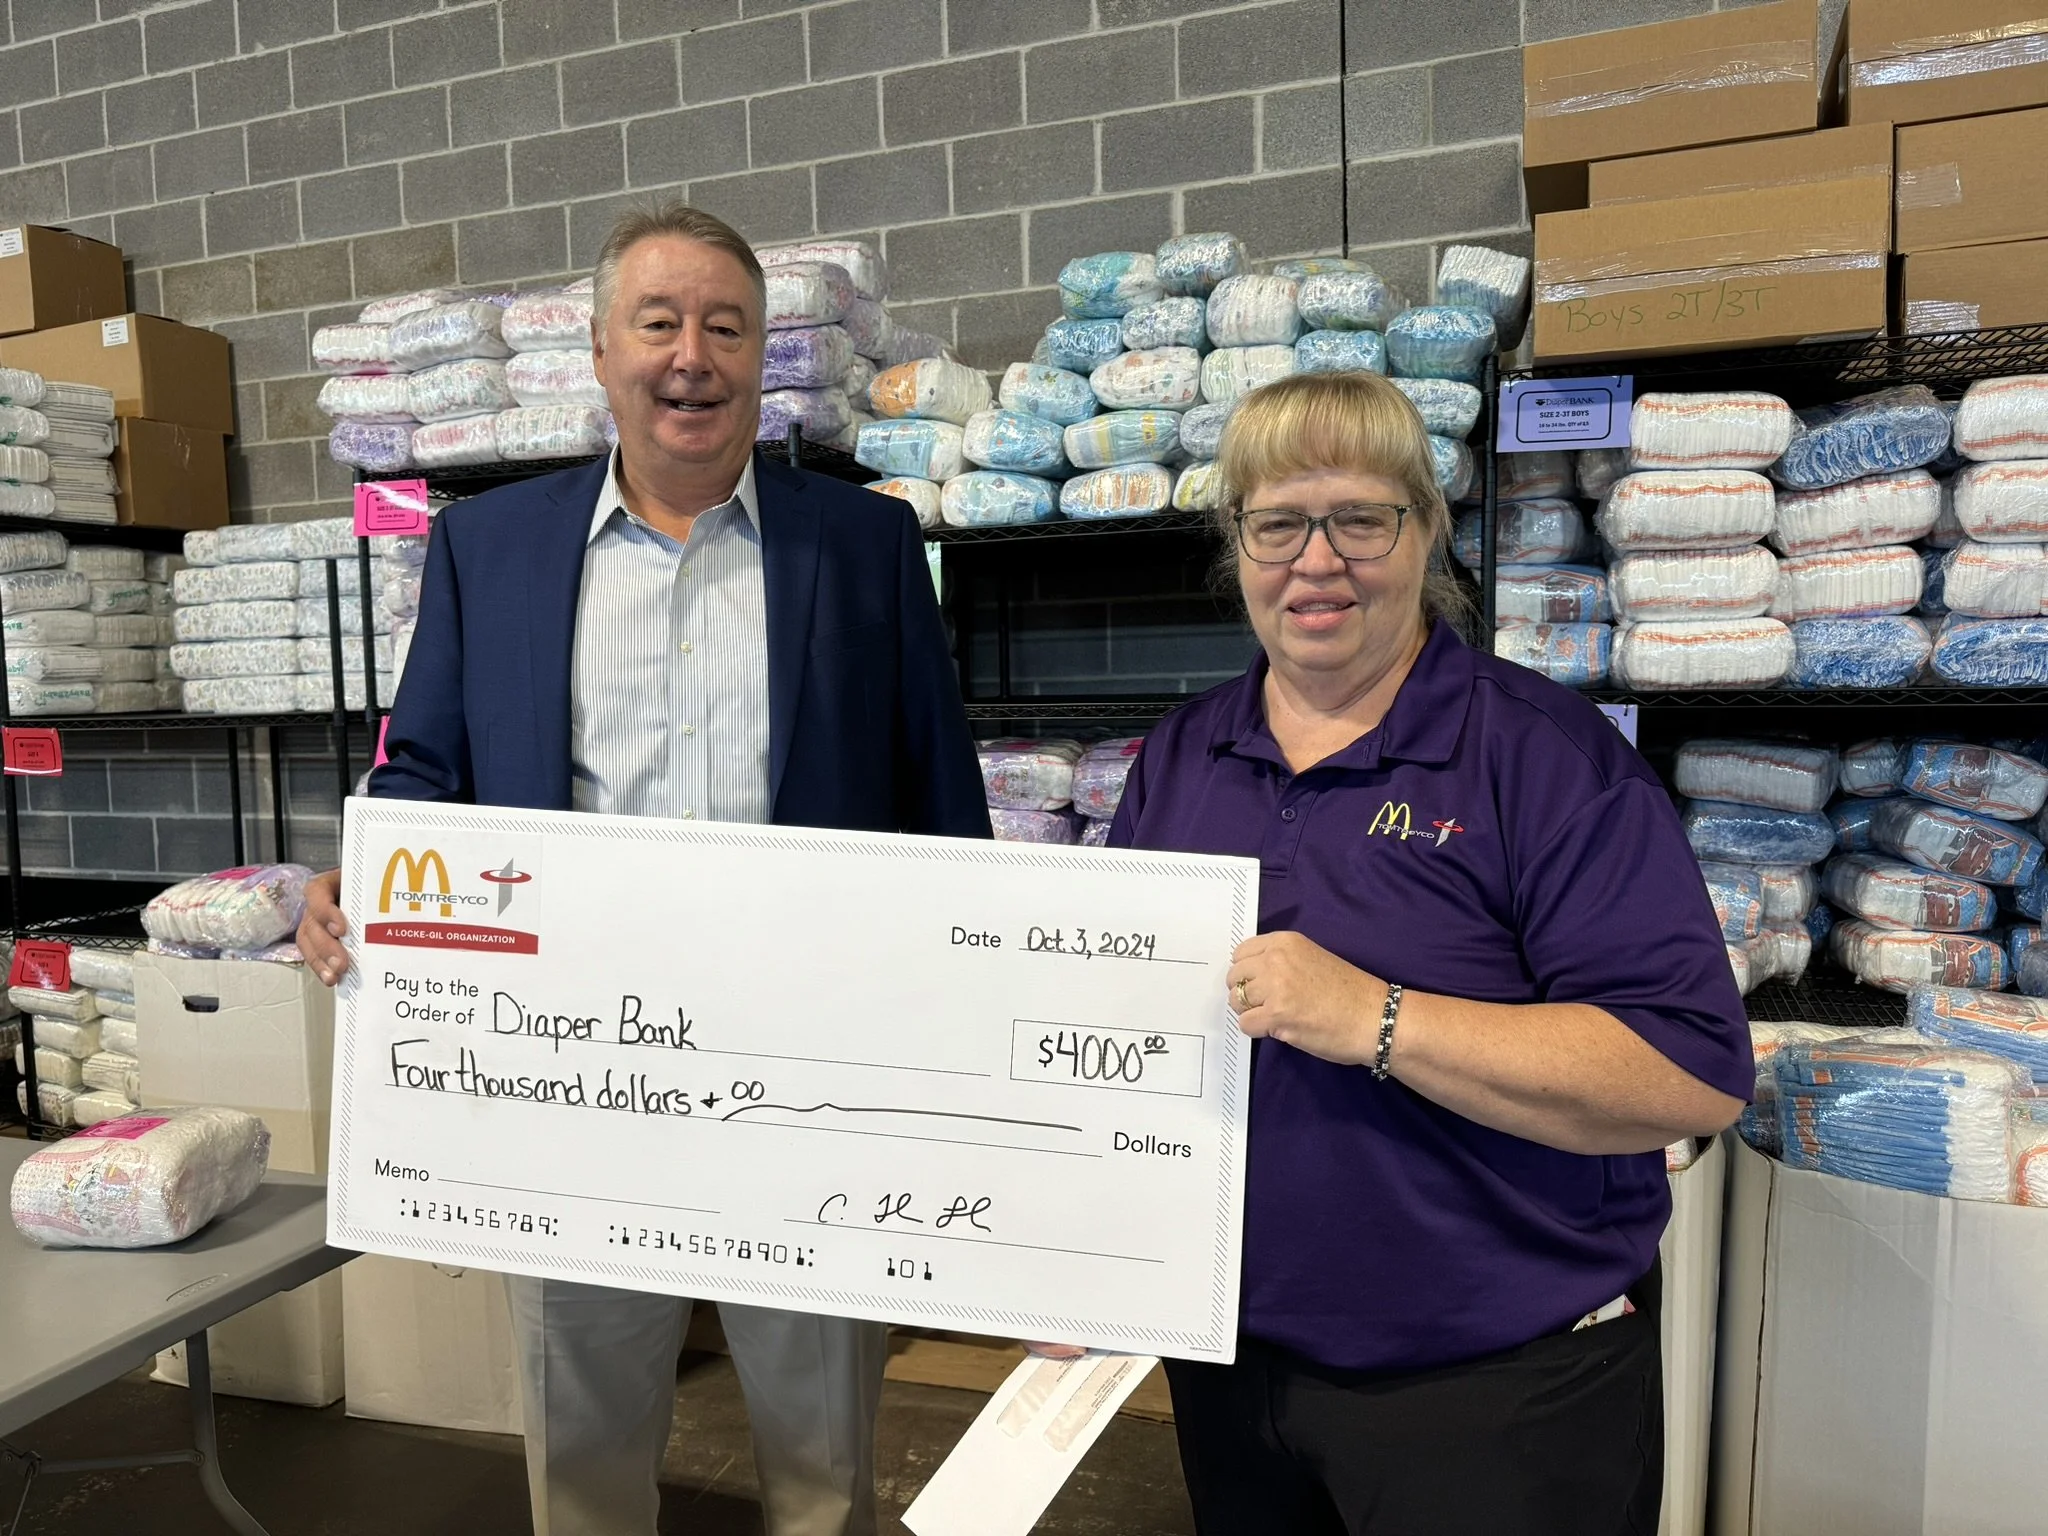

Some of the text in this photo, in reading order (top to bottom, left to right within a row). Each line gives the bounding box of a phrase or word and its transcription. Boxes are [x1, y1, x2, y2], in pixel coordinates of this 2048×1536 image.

[1558, 280, 1777, 332] Boys 2T/3T
[392, 891, 489, 906] TOMTREYCO
[386, 928, 516, 944] A LOCKE-GIL ORGANIZATION
[951, 926, 1001, 948] Date
[1098, 931, 1156, 961] 2024
[384, 972, 478, 998] Pay to the
[395, 1000, 475, 1024] Order of
[493, 991, 697, 1053] Diaper Bank
[391, 1039, 451, 1091] Four
[454, 1047, 587, 1106] thousand
[596, 1069, 692, 1116] dollars
[1114, 1132, 1192, 1158] Dollars
[374, 1159, 430, 1182] Memo
